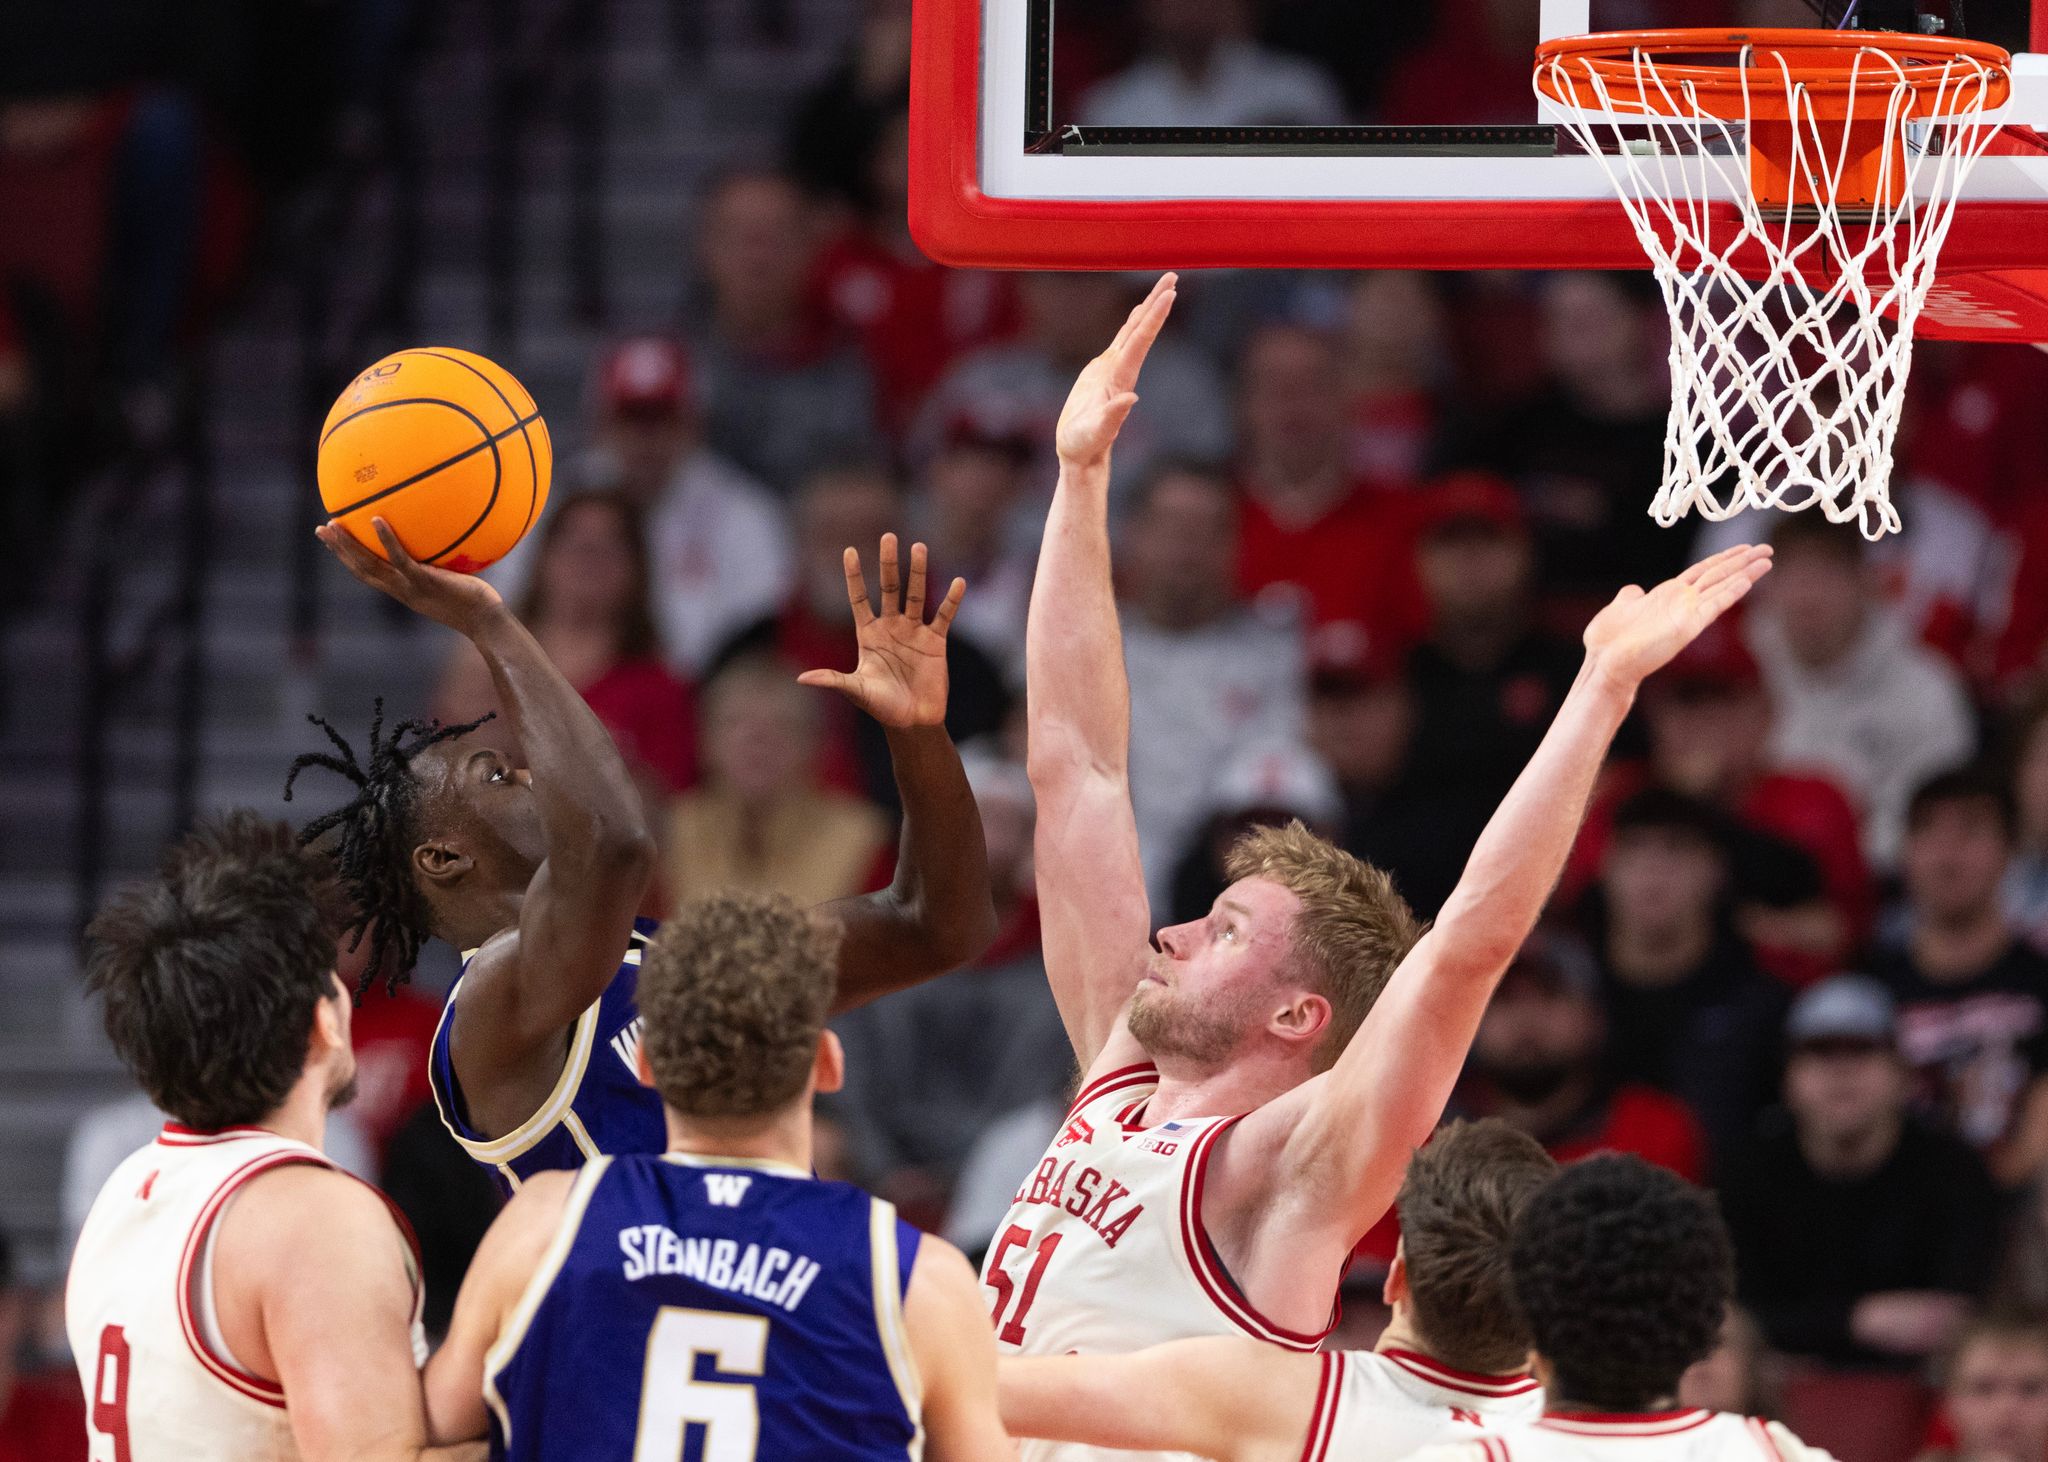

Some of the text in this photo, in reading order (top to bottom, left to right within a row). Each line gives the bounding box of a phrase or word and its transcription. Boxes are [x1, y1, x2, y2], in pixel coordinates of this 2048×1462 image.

[703, 1173, 752, 1207] W
[986, 1223, 1063, 1346] 51
[93, 1324, 132, 1462] 9
[632, 1304, 770, 1462] 6
